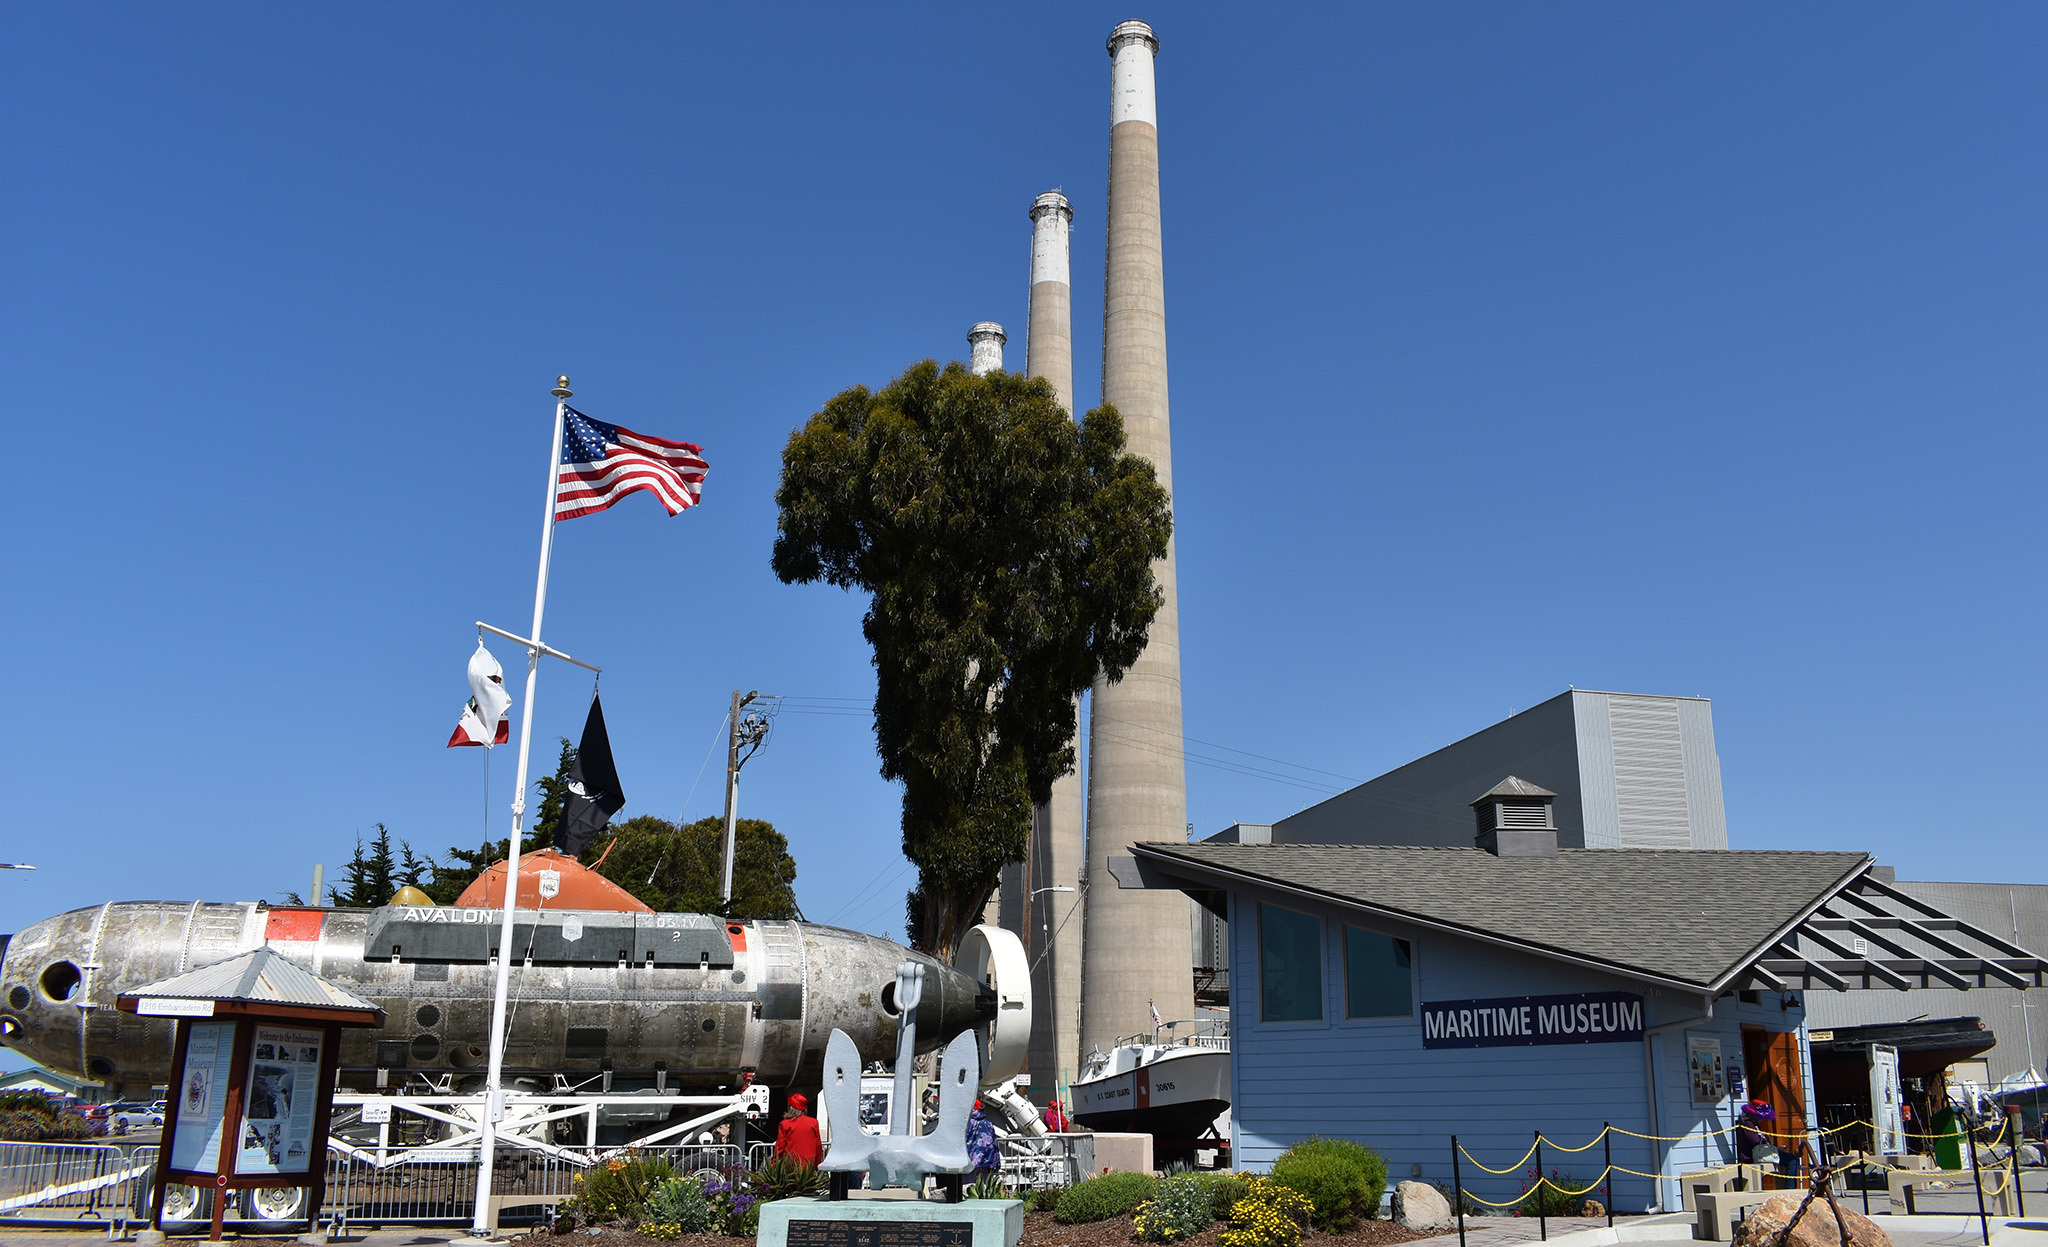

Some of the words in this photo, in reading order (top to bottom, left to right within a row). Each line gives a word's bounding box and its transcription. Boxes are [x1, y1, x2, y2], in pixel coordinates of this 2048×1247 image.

[403, 908, 494, 924] AVALON
[140, 1002, 157, 1011] 1210
[158, 1002, 201, 1012] Embarcadero
[1424, 1006, 1533, 1040] MARITIME
[1538, 1001, 1643, 1035] MUSEUM
[258, 1030, 279, 1042] Welcome
[189, 1042, 217, 1055] Maritime
[187, 1057, 214, 1070] Museum
[1155, 1081, 1176, 1092] 30615
[762, 1095, 768, 1104] 2
[1105, 1090, 1116, 1100] COAST
[1116, 1087, 1131, 1098] GUARD
